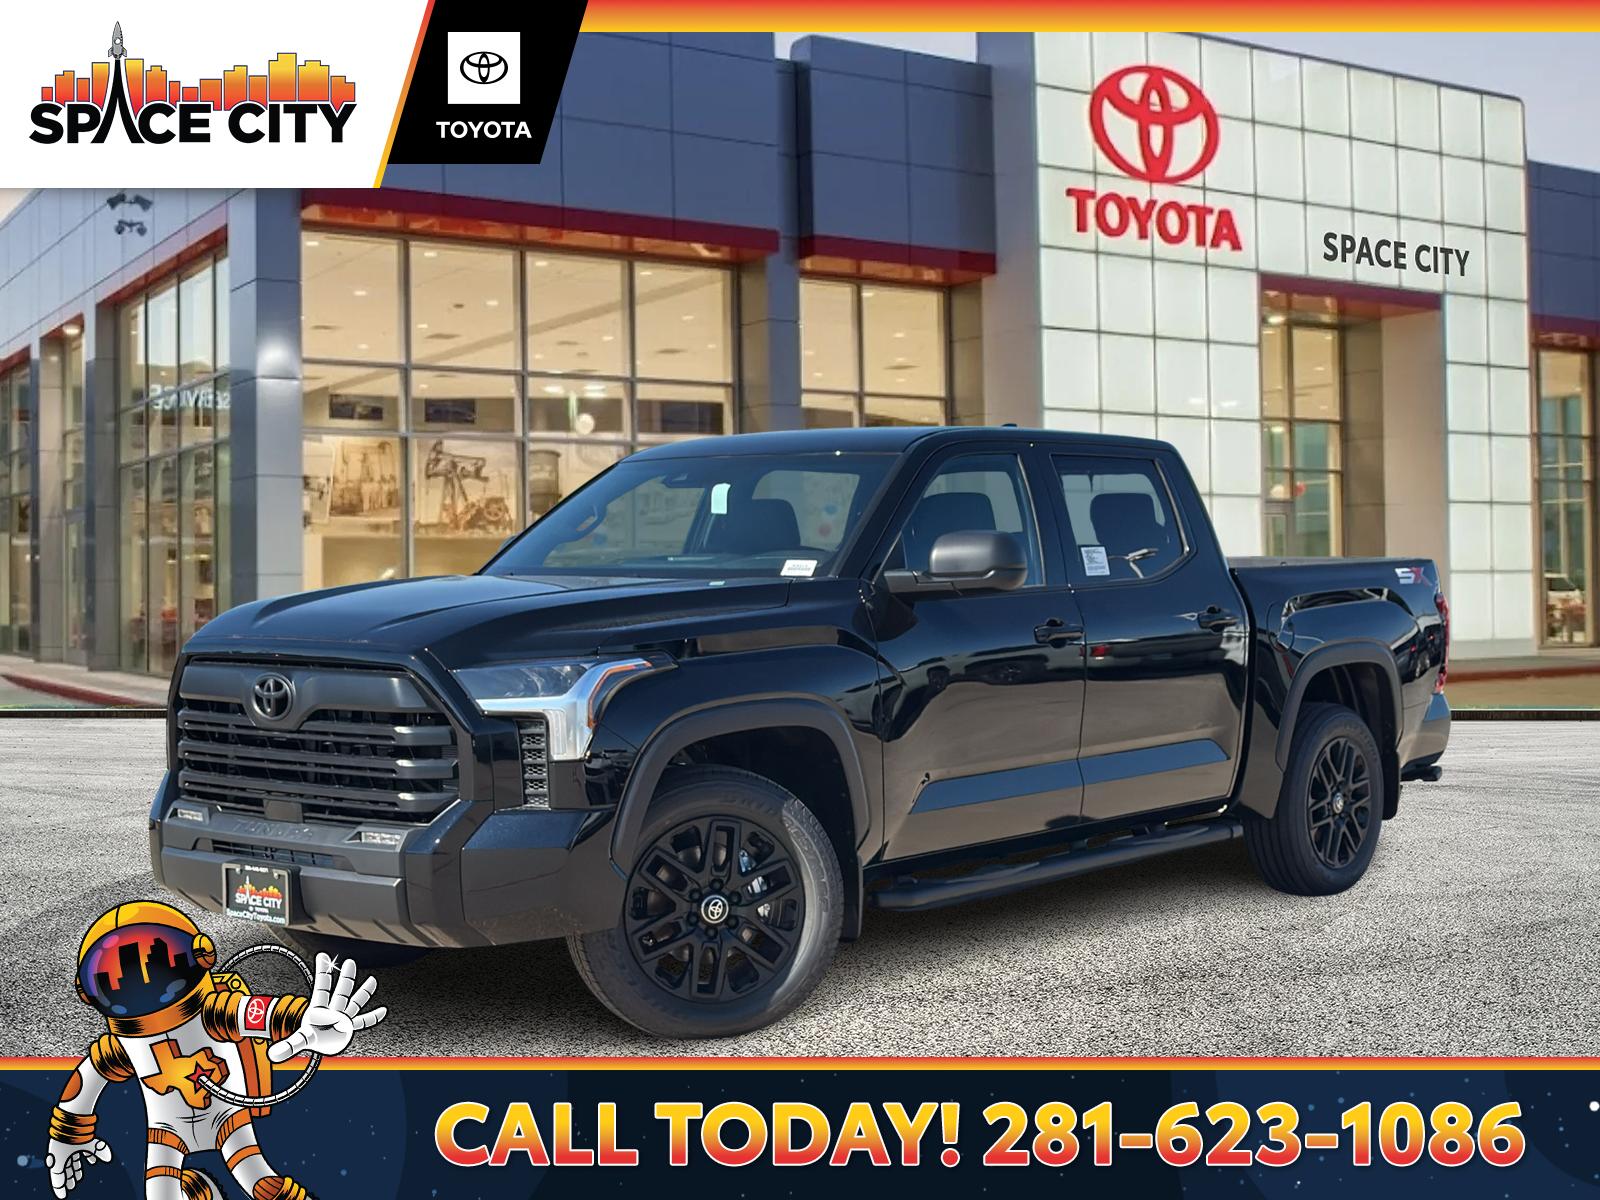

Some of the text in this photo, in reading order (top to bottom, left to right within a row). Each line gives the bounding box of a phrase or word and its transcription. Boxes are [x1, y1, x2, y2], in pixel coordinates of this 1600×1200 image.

[1066, 188, 1243, 251] TOYOTA
[1323, 232, 1470, 277] SPACE CITY
[235, 890, 282, 909] SPACE CITY
